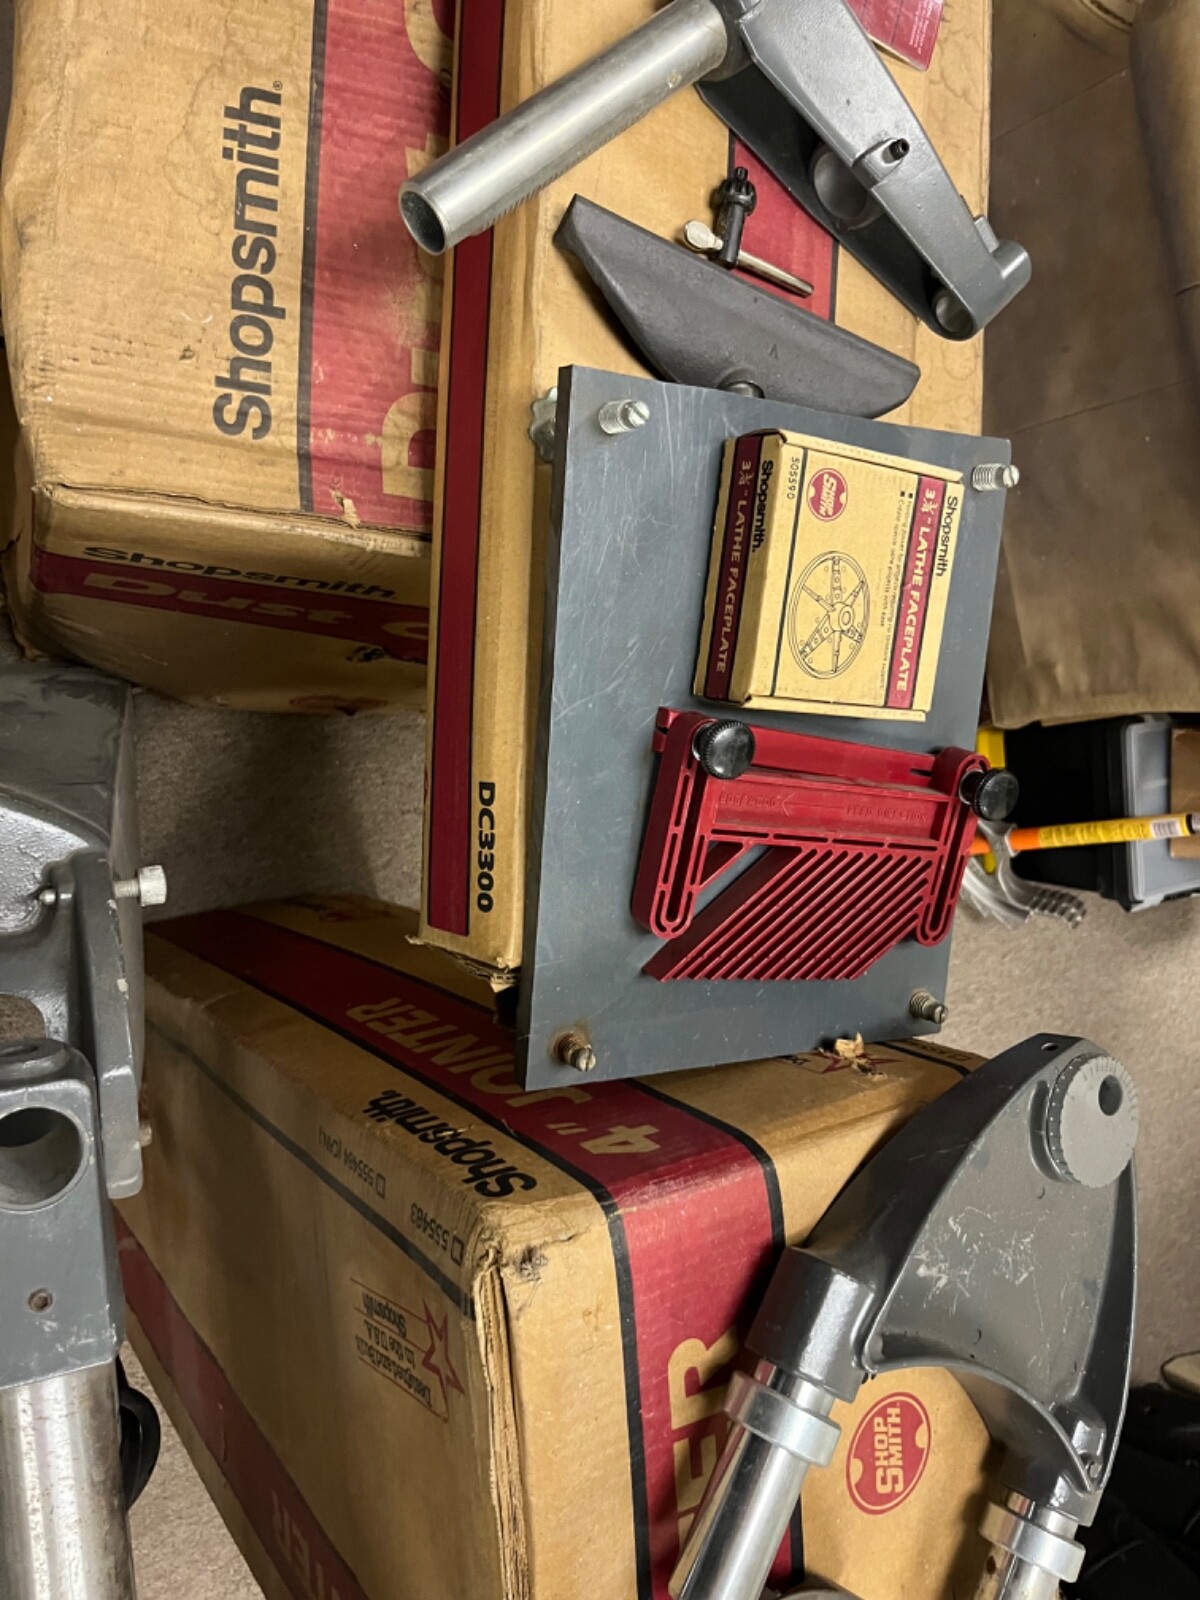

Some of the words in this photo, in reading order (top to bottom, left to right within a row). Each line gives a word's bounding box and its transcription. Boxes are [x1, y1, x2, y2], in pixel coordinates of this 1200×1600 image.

[786, 456, 801, 501] 505590
[731, 500, 748, 562] LATHE
[912, 526, 931, 587] LATHE
[83, 572, 352, 625] Dust
[715, 567, 739, 674] FACEPLATE
[896, 589, 921, 692] FACEPLATE
[477, 781, 496, 914] DC3300
[411, 1202, 450, 1251] 555483
